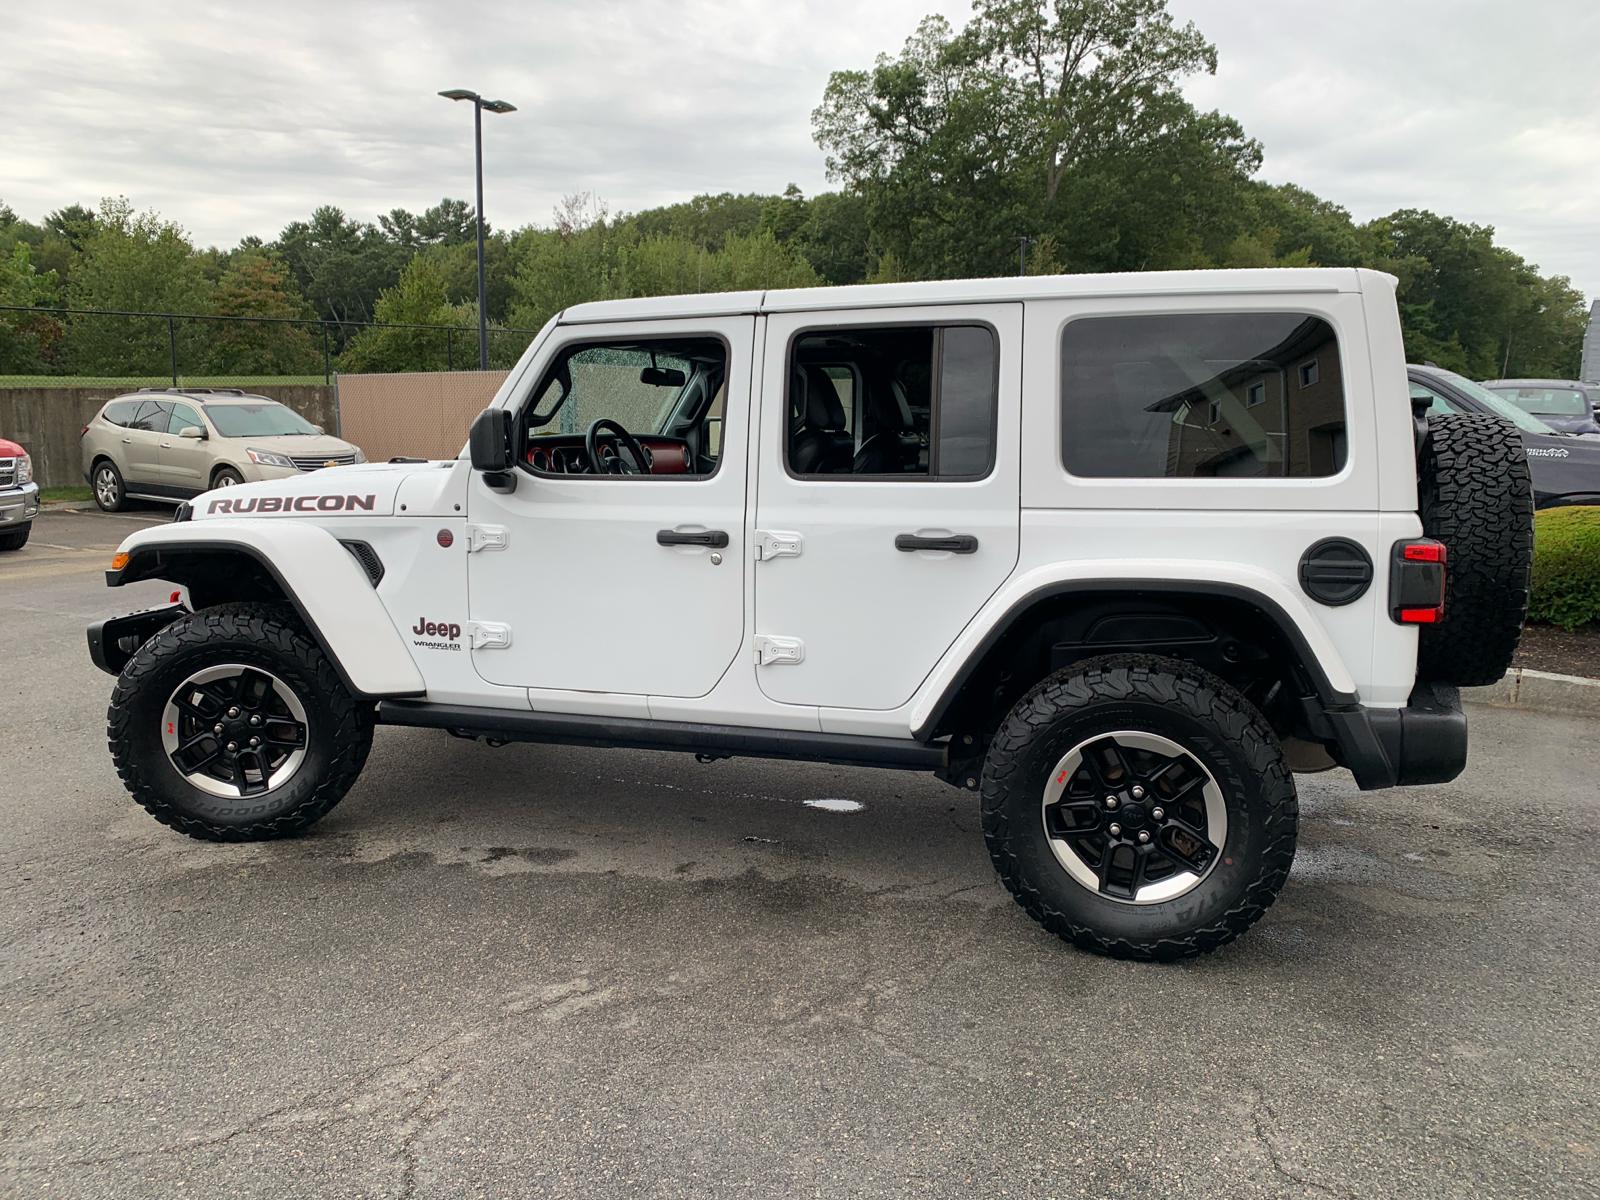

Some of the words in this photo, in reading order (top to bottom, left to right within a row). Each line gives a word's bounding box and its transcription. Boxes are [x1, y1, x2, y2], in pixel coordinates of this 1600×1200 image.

[207, 494, 376, 514] RUBICON
[412, 616, 461, 641] Jeep
[413, 640, 461, 649] WRANGLER
